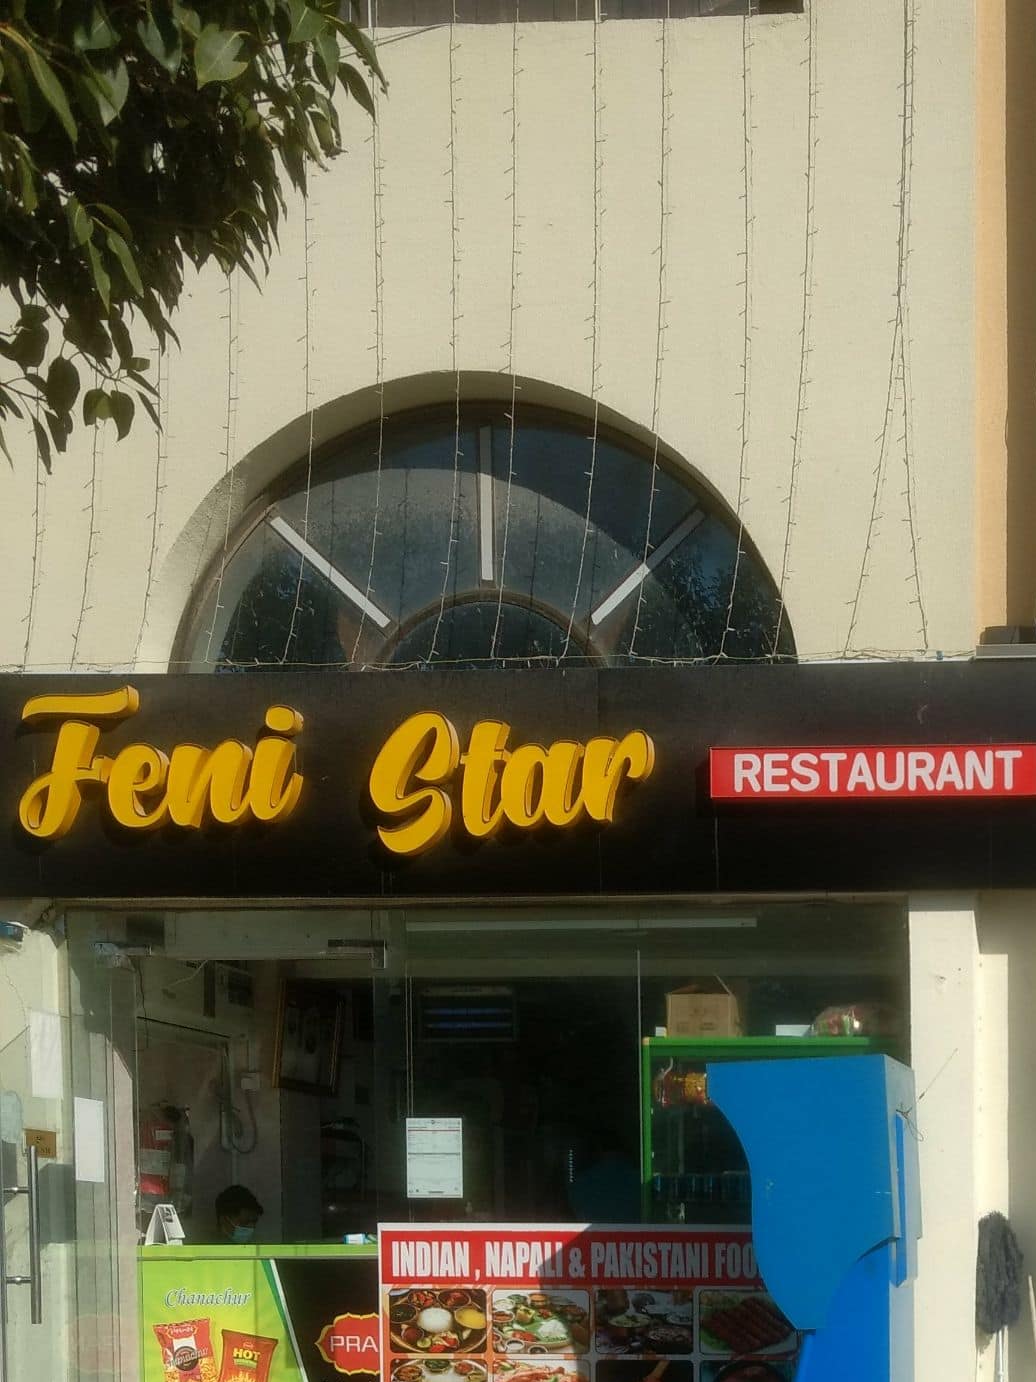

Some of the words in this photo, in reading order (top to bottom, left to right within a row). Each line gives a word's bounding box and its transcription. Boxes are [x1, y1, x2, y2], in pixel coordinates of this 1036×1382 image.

[19, 685, 304, 838] Feni
[369, 711, 655, 853] Star
[733, 749, 1023, 793] RESTAURANT
[392, 1241, 469, 1277] INDIAN
[486, 1241, 563, 1278] NAPALI
[569, 1248, 585, 1278] &
[591, 1241, 709, 1279] PAKISTANI
[715, 1242, 758, 1279] FOO
[164, 1287, 252, 1309] Chanachur
[233, 1347, 261, 1361] HOT
[330, 1335, 379, 1353] PRA
